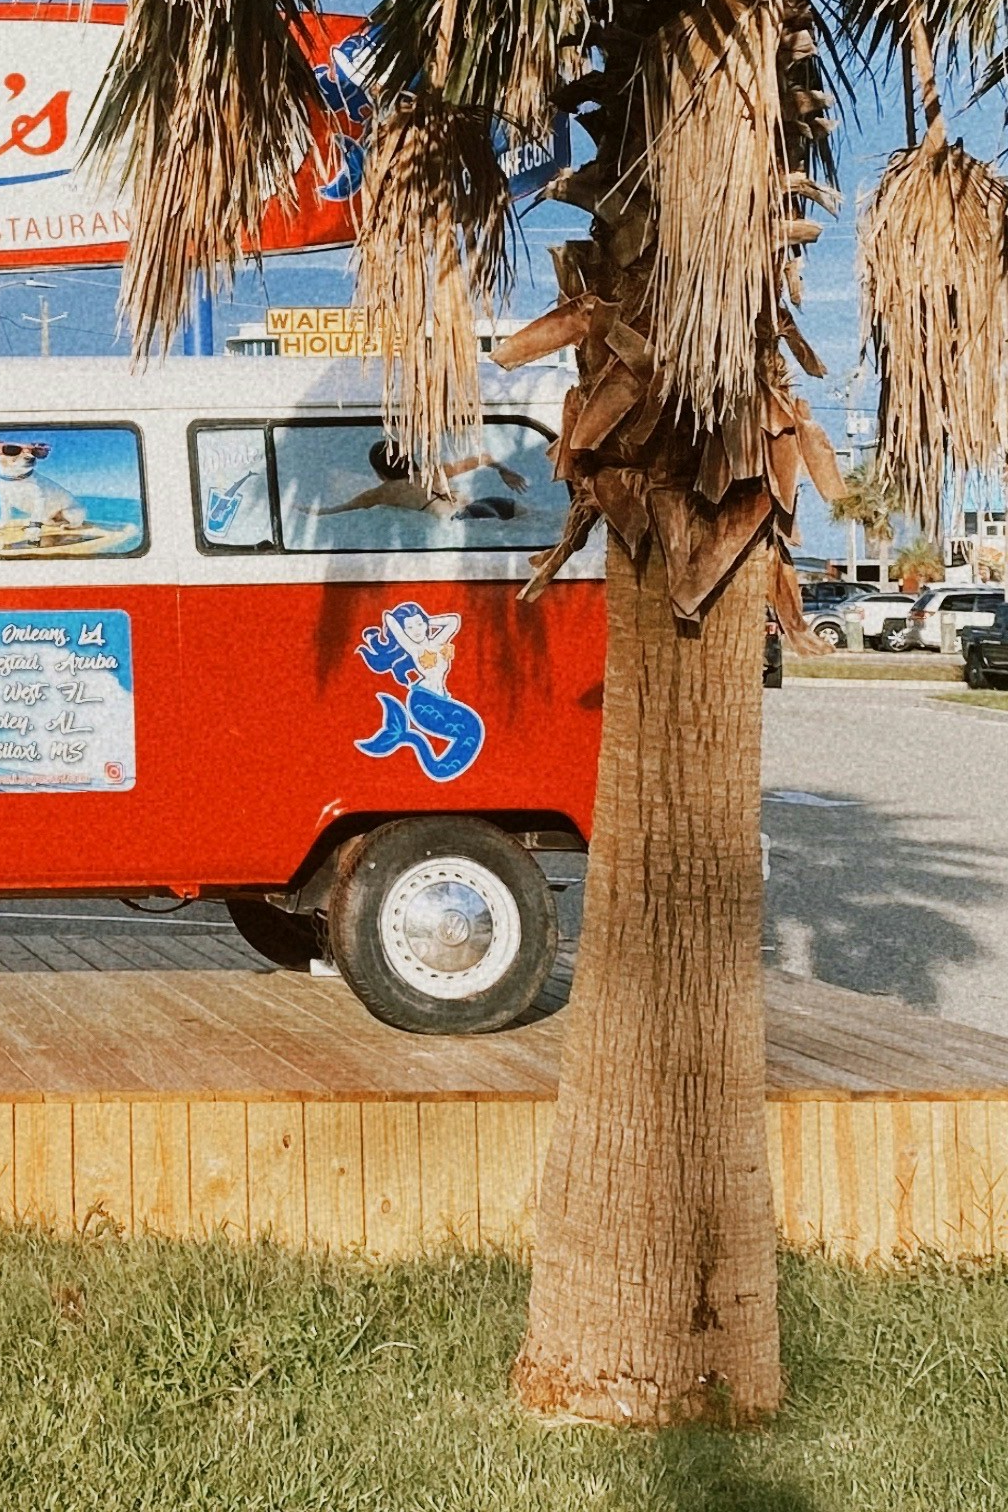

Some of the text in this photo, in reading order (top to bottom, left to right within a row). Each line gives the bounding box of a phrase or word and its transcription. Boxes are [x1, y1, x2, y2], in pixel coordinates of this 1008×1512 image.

[270, 312, 382, 330] WAFF
[77, 622, 106, 646] LA
[54, 652, 119, 676] Aruba
[56, 681, 104, 704] FL
[45, 710, 94, 734] AL
[50, 740, 87, 763] MS
